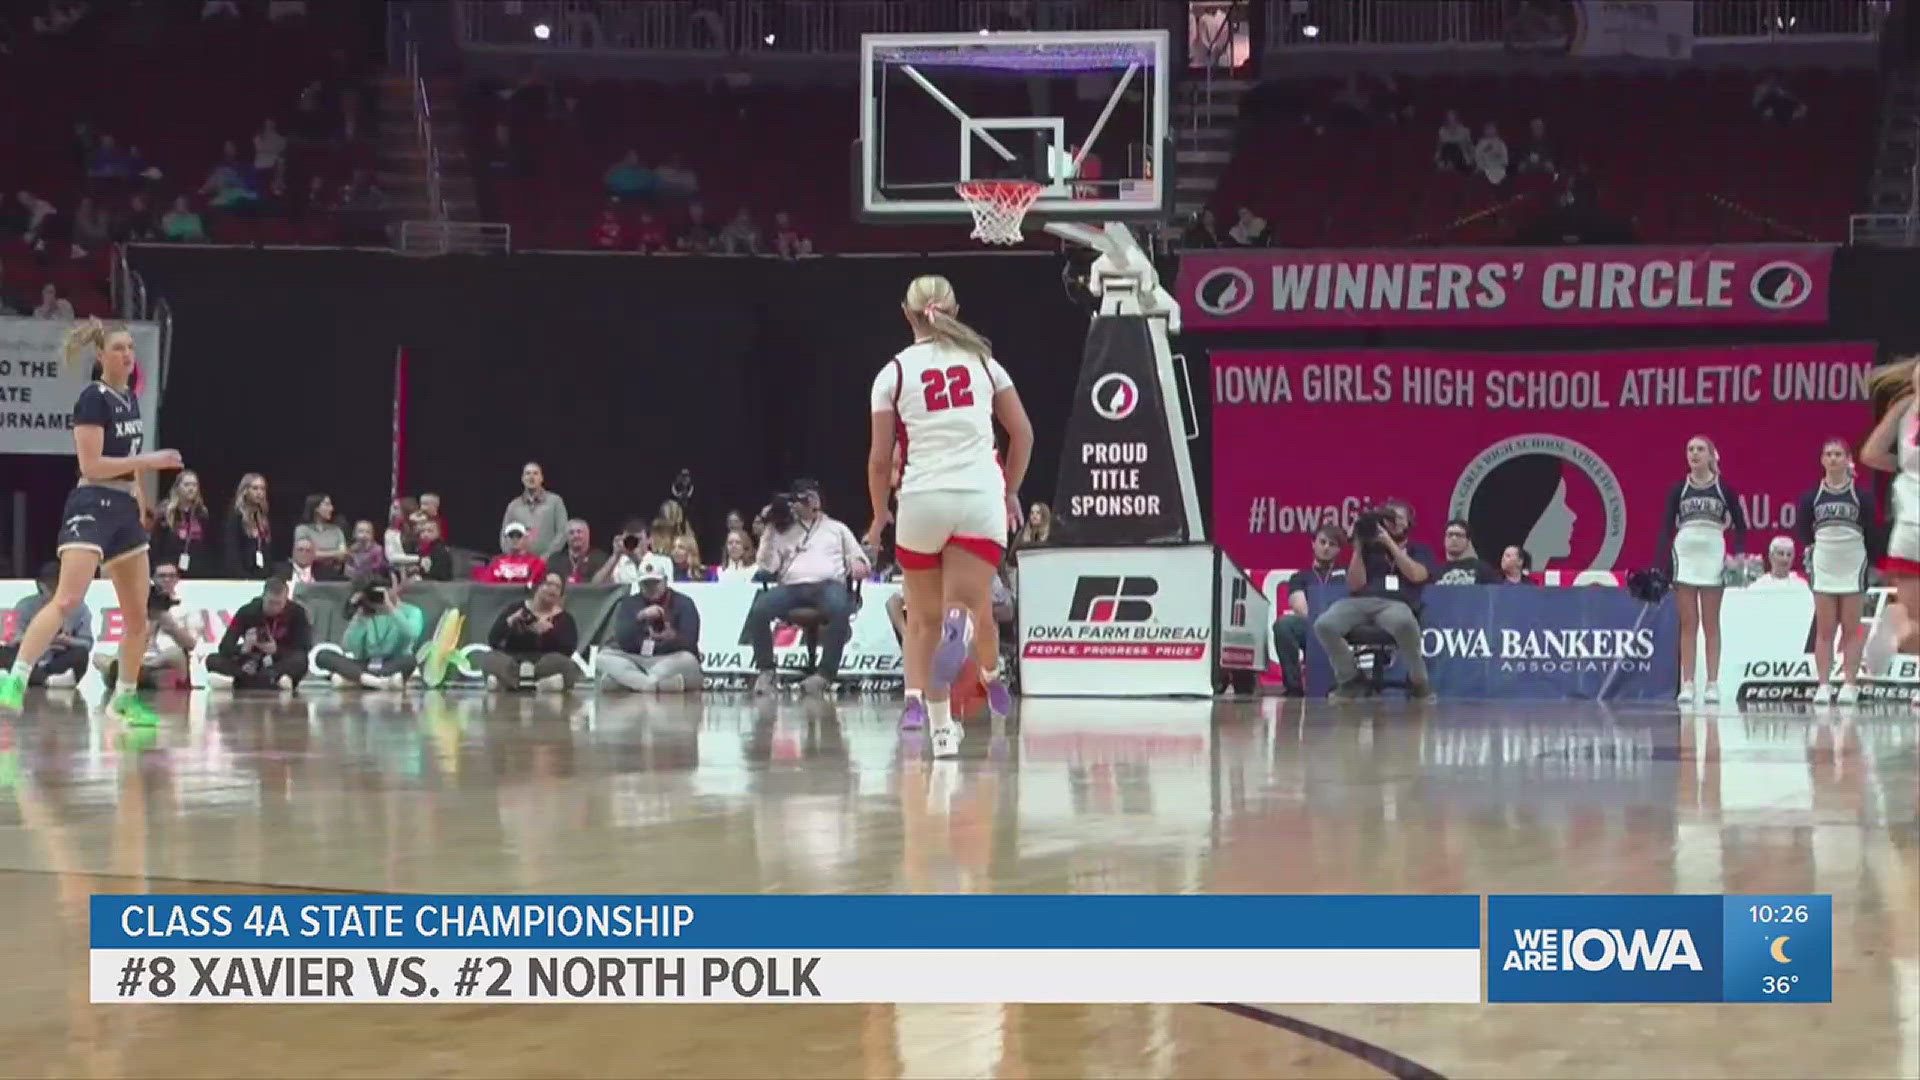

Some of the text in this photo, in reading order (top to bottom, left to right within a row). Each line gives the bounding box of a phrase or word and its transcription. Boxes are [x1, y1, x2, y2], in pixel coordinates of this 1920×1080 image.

[1541, 260, 1736, 309] CIRCLE
[20, 361, 58, 377] THE
[920, 364, 975, 413] 22
[1215, 361, 1873, 410] IOWA GIRLS HIGH SCHOOL ATHLETIC UNION
[1082, 443, 1149, 464] PROUD
[1091, 469, 1140, 490] TITLE
[1071, 495, 1161, 516] SPONSOR
[1028, 626, 1074, 639] IOWA
[1078, 626, 1129, 639] FARM
[1133, 626, 1211, 640] BUREAU
[1420, 628, 1655, 659] OWA BANKERS
[1501, 661, 1651, 672] ASSOCIATION
[1744, 661, 1812, 678] IOWA
